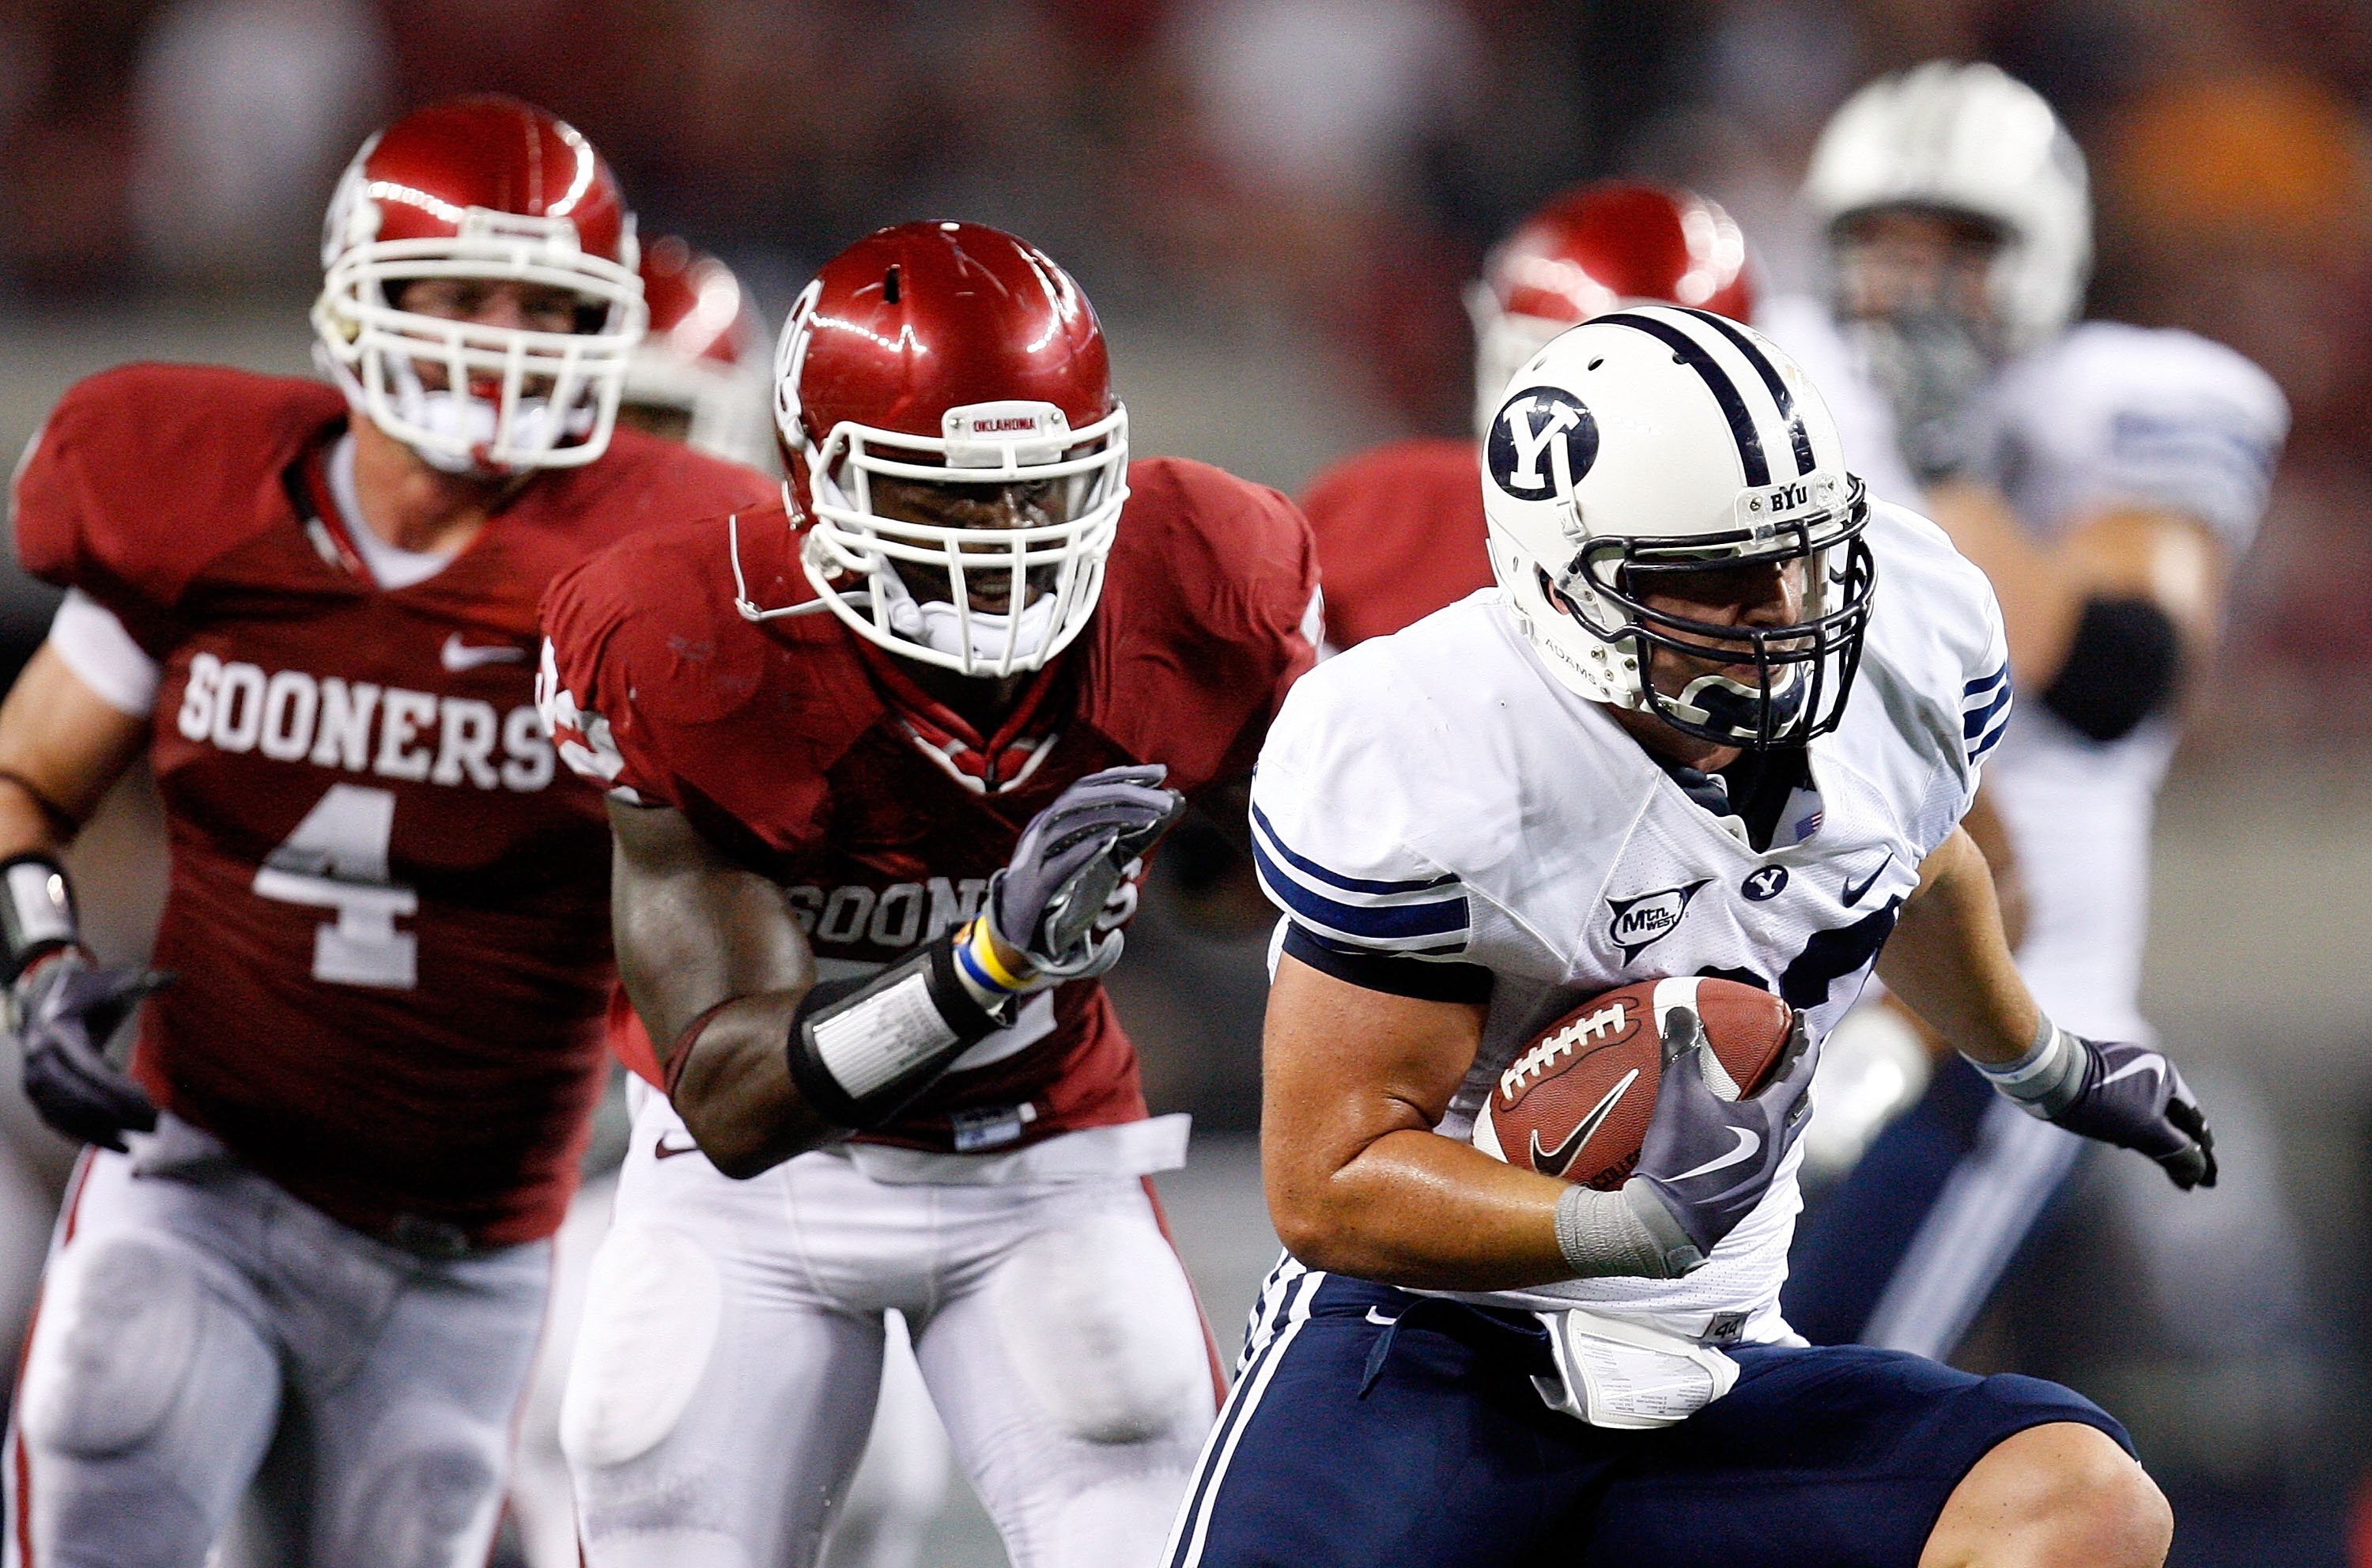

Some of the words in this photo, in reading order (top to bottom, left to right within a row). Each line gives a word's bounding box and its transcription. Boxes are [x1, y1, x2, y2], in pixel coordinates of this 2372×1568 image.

[973, 417, 1036, 432] OKLAHOMA
[1503, 395, 1581, 490] Y
[1770, 482, 1807, 512] BYU
[1545, 638, 1597, 686] ADAMS
[177, 652, 555, 792] SOONERS
[252, 783, 418, 989] 4
[784, 856, 1143, 947] SOONS
[1750, 869, 1783, 897] Y
[1646, 913, 1676, 931] WEST
